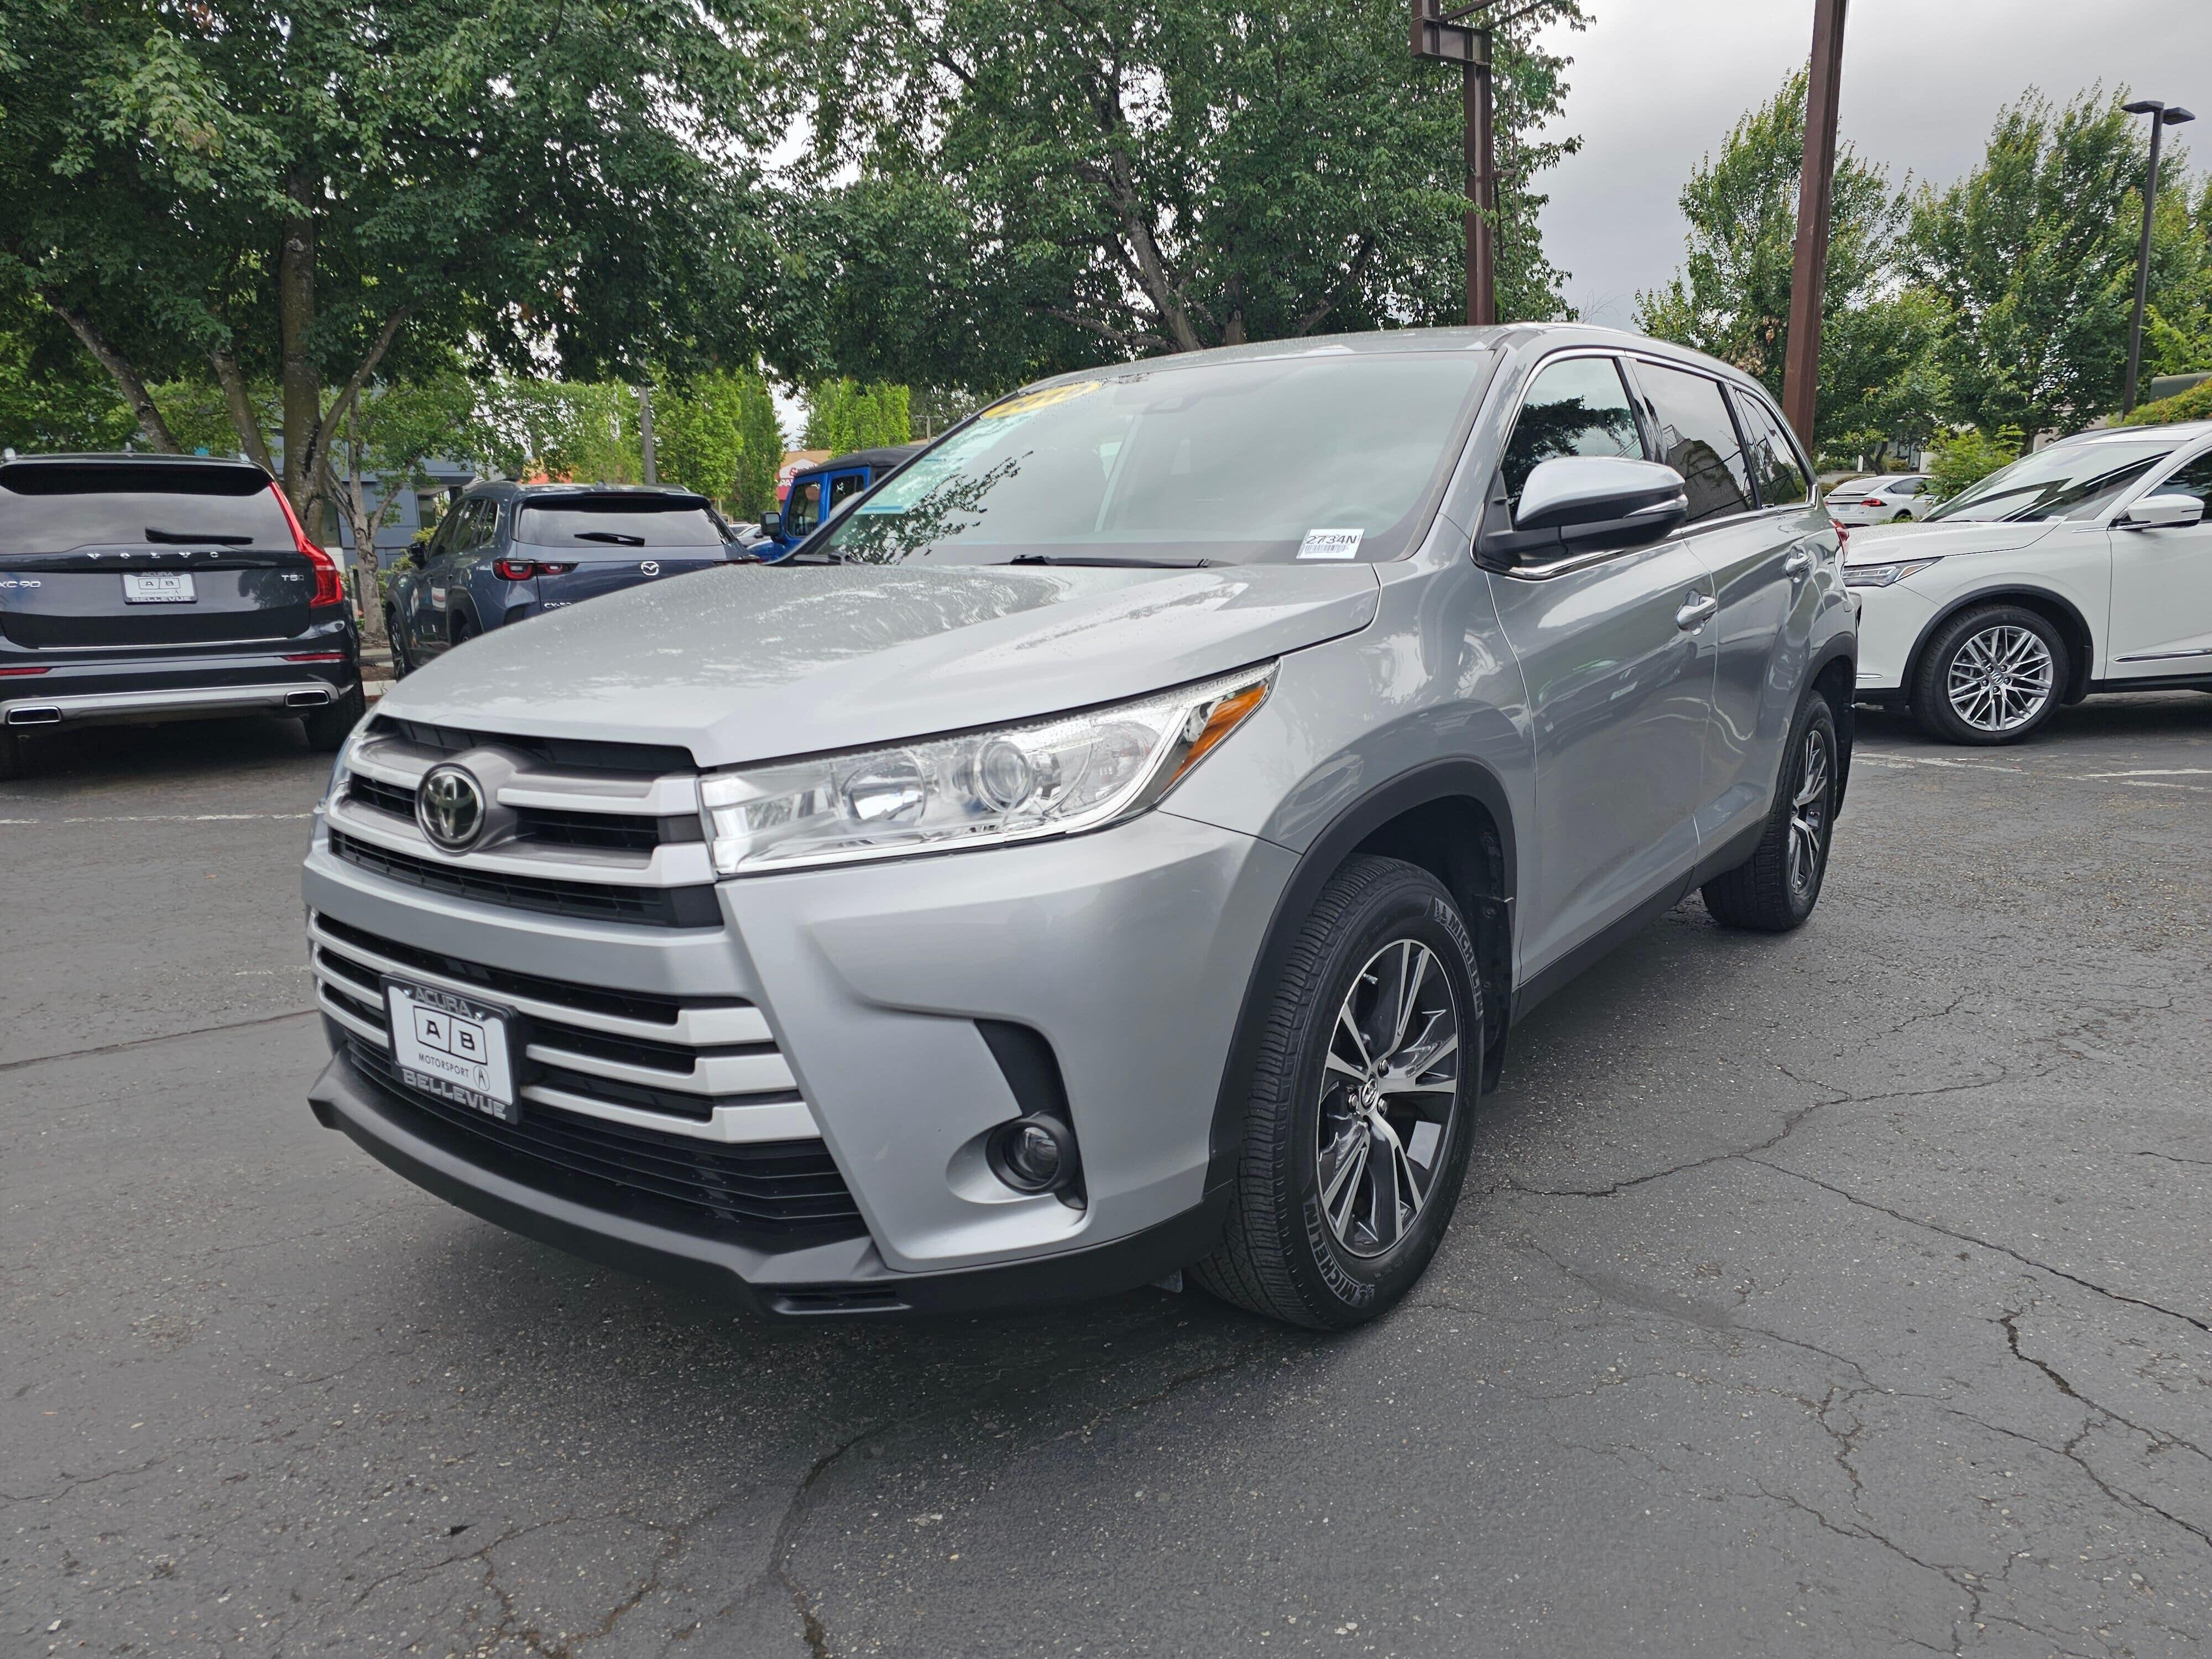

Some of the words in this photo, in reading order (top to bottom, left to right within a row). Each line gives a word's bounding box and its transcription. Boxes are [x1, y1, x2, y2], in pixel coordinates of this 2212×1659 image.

[1305, 535, 1358, 544] 2734N
[1448, 912, 1484, 1018] MICHELIN
[416, 987, 472, 1018] ACURA
[426, 1019, 441, 1040] A
[458, 1030, 476, 1051] B
[419, 1053, 469, 1078] MOTORSPORT
[401, 1068, 507, 1120] BELLEVUE
[1304, 1202, 1359, 1302] MICHELIN
